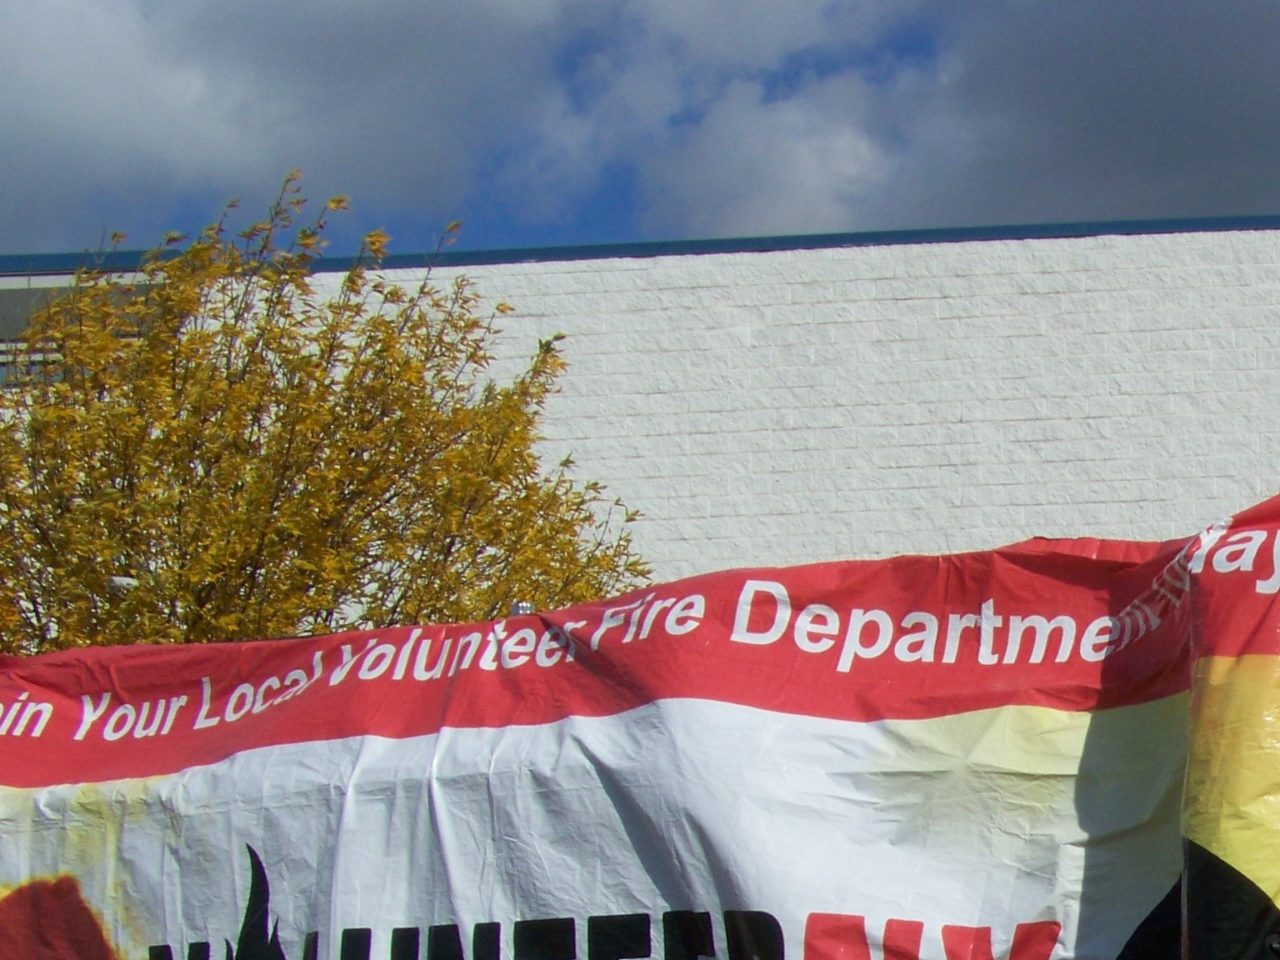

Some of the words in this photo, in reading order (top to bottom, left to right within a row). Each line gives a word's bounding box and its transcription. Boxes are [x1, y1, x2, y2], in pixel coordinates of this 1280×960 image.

[0, 691, 53, 738] in
[74, 692, 188, 741] Your
[193, 651, 324, 730] Local
[329, 615, 588, 687] Volunteer
[590, 592, 706, 650] Fire
